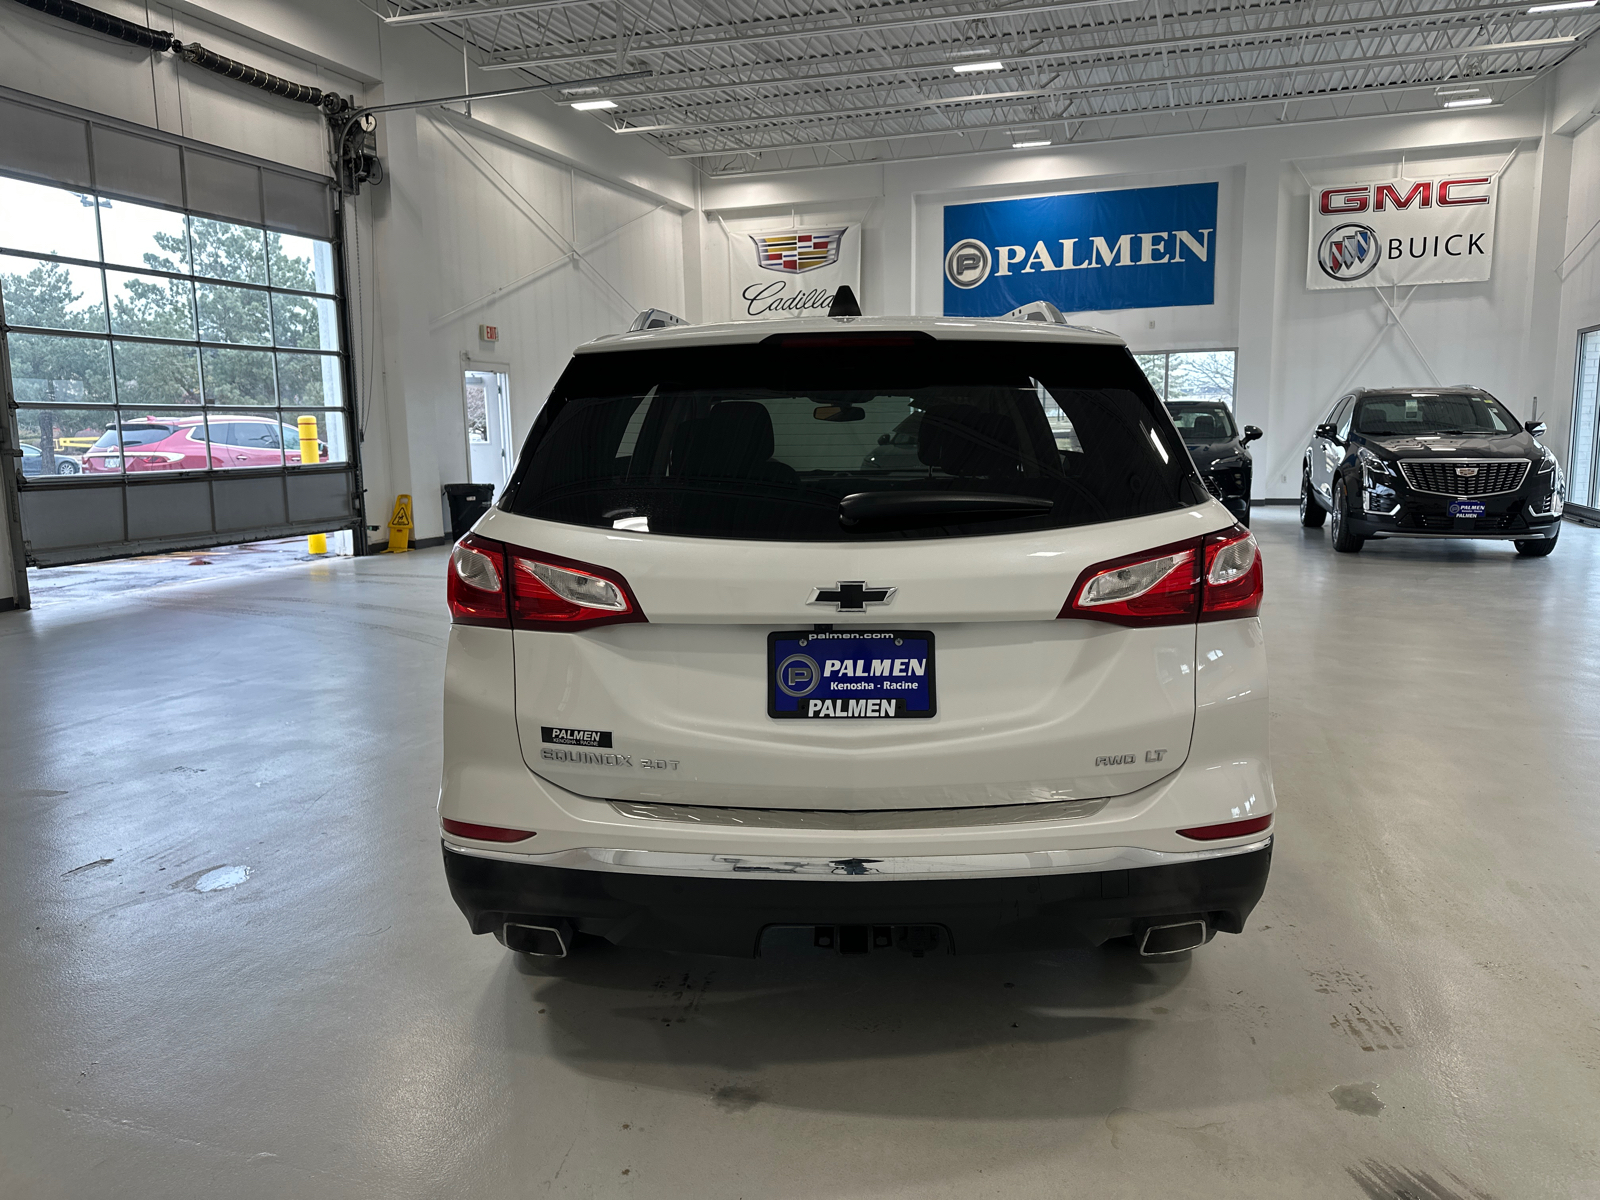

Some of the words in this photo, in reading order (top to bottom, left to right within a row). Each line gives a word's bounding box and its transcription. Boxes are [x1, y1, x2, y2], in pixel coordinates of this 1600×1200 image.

[1319, 176, 1491, 216] GMC
[994, 229, 1213, 276] PALMEN
[1388, 233, 1485, 259] BUICK
[742, 280, 835, 316] Cadilla
[808, 632, 894, 641] palmen.com
[823, 659, 926, 677] PALMEN
[830, 681, 875, 690] Kenosha
[883, 681, 918, 690] Racine
[808, 699, 897, 718] PALMEN
[552, 729, 600, 741] PALMEN
[541, 748, 633, 767] EQUINOX
[1095, 754, 1136, 766] AWD
[1145, 749, 1167, 762] LT
